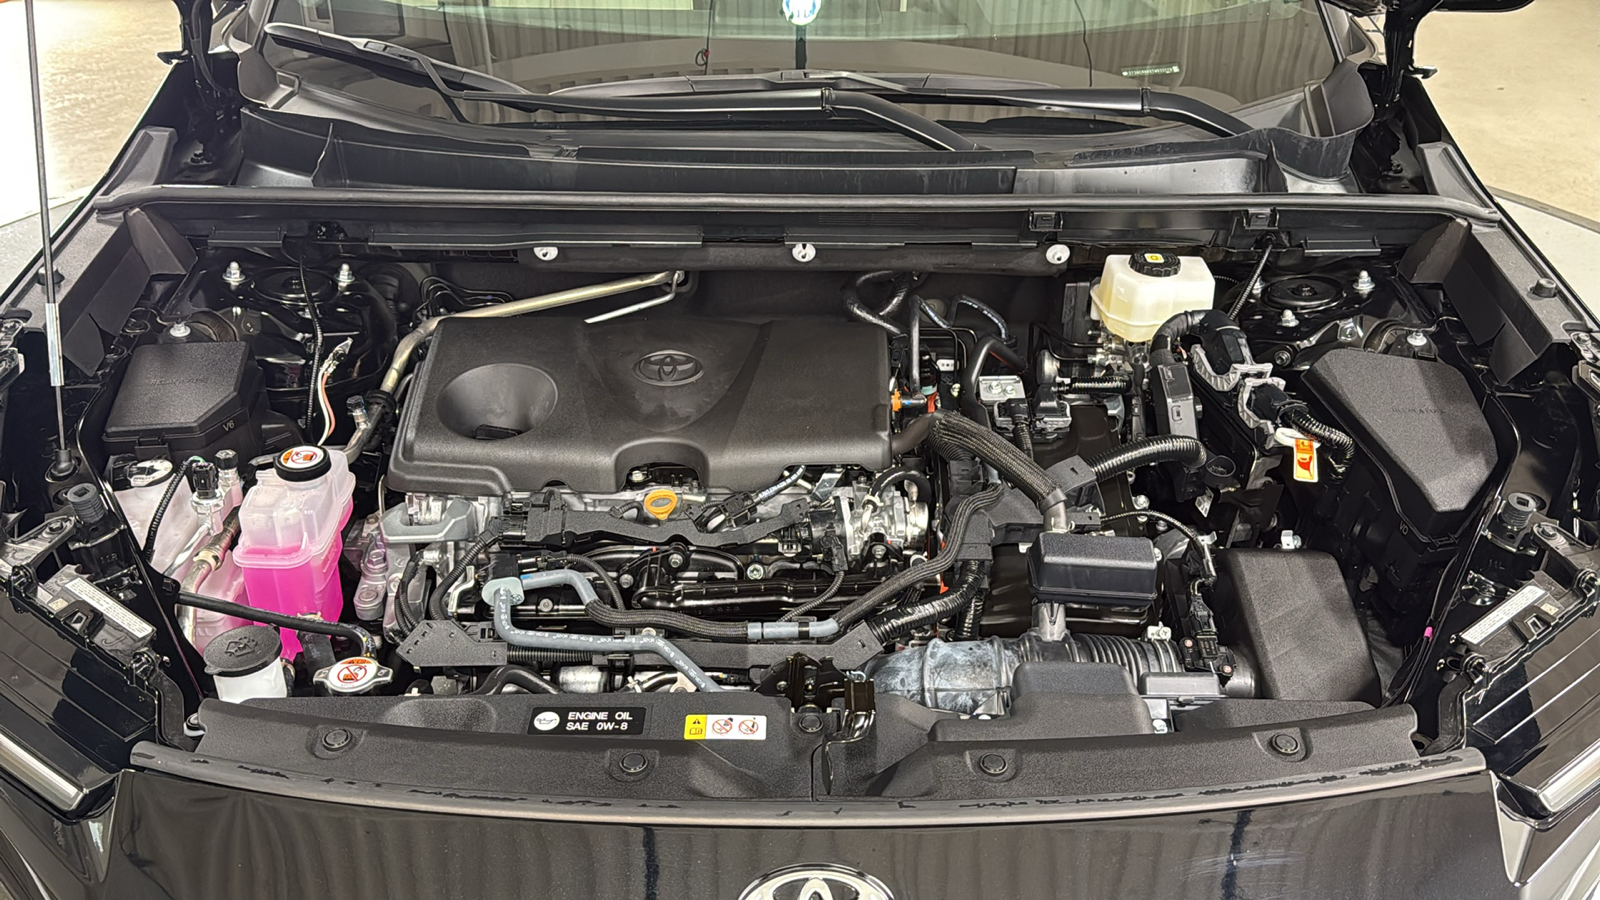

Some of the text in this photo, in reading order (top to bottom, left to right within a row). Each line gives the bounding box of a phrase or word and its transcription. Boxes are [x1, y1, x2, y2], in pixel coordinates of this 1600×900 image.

[567, 711, 633, 721] ENGINE OIL
[565, 722, 629, 731] SAE 0W-8
